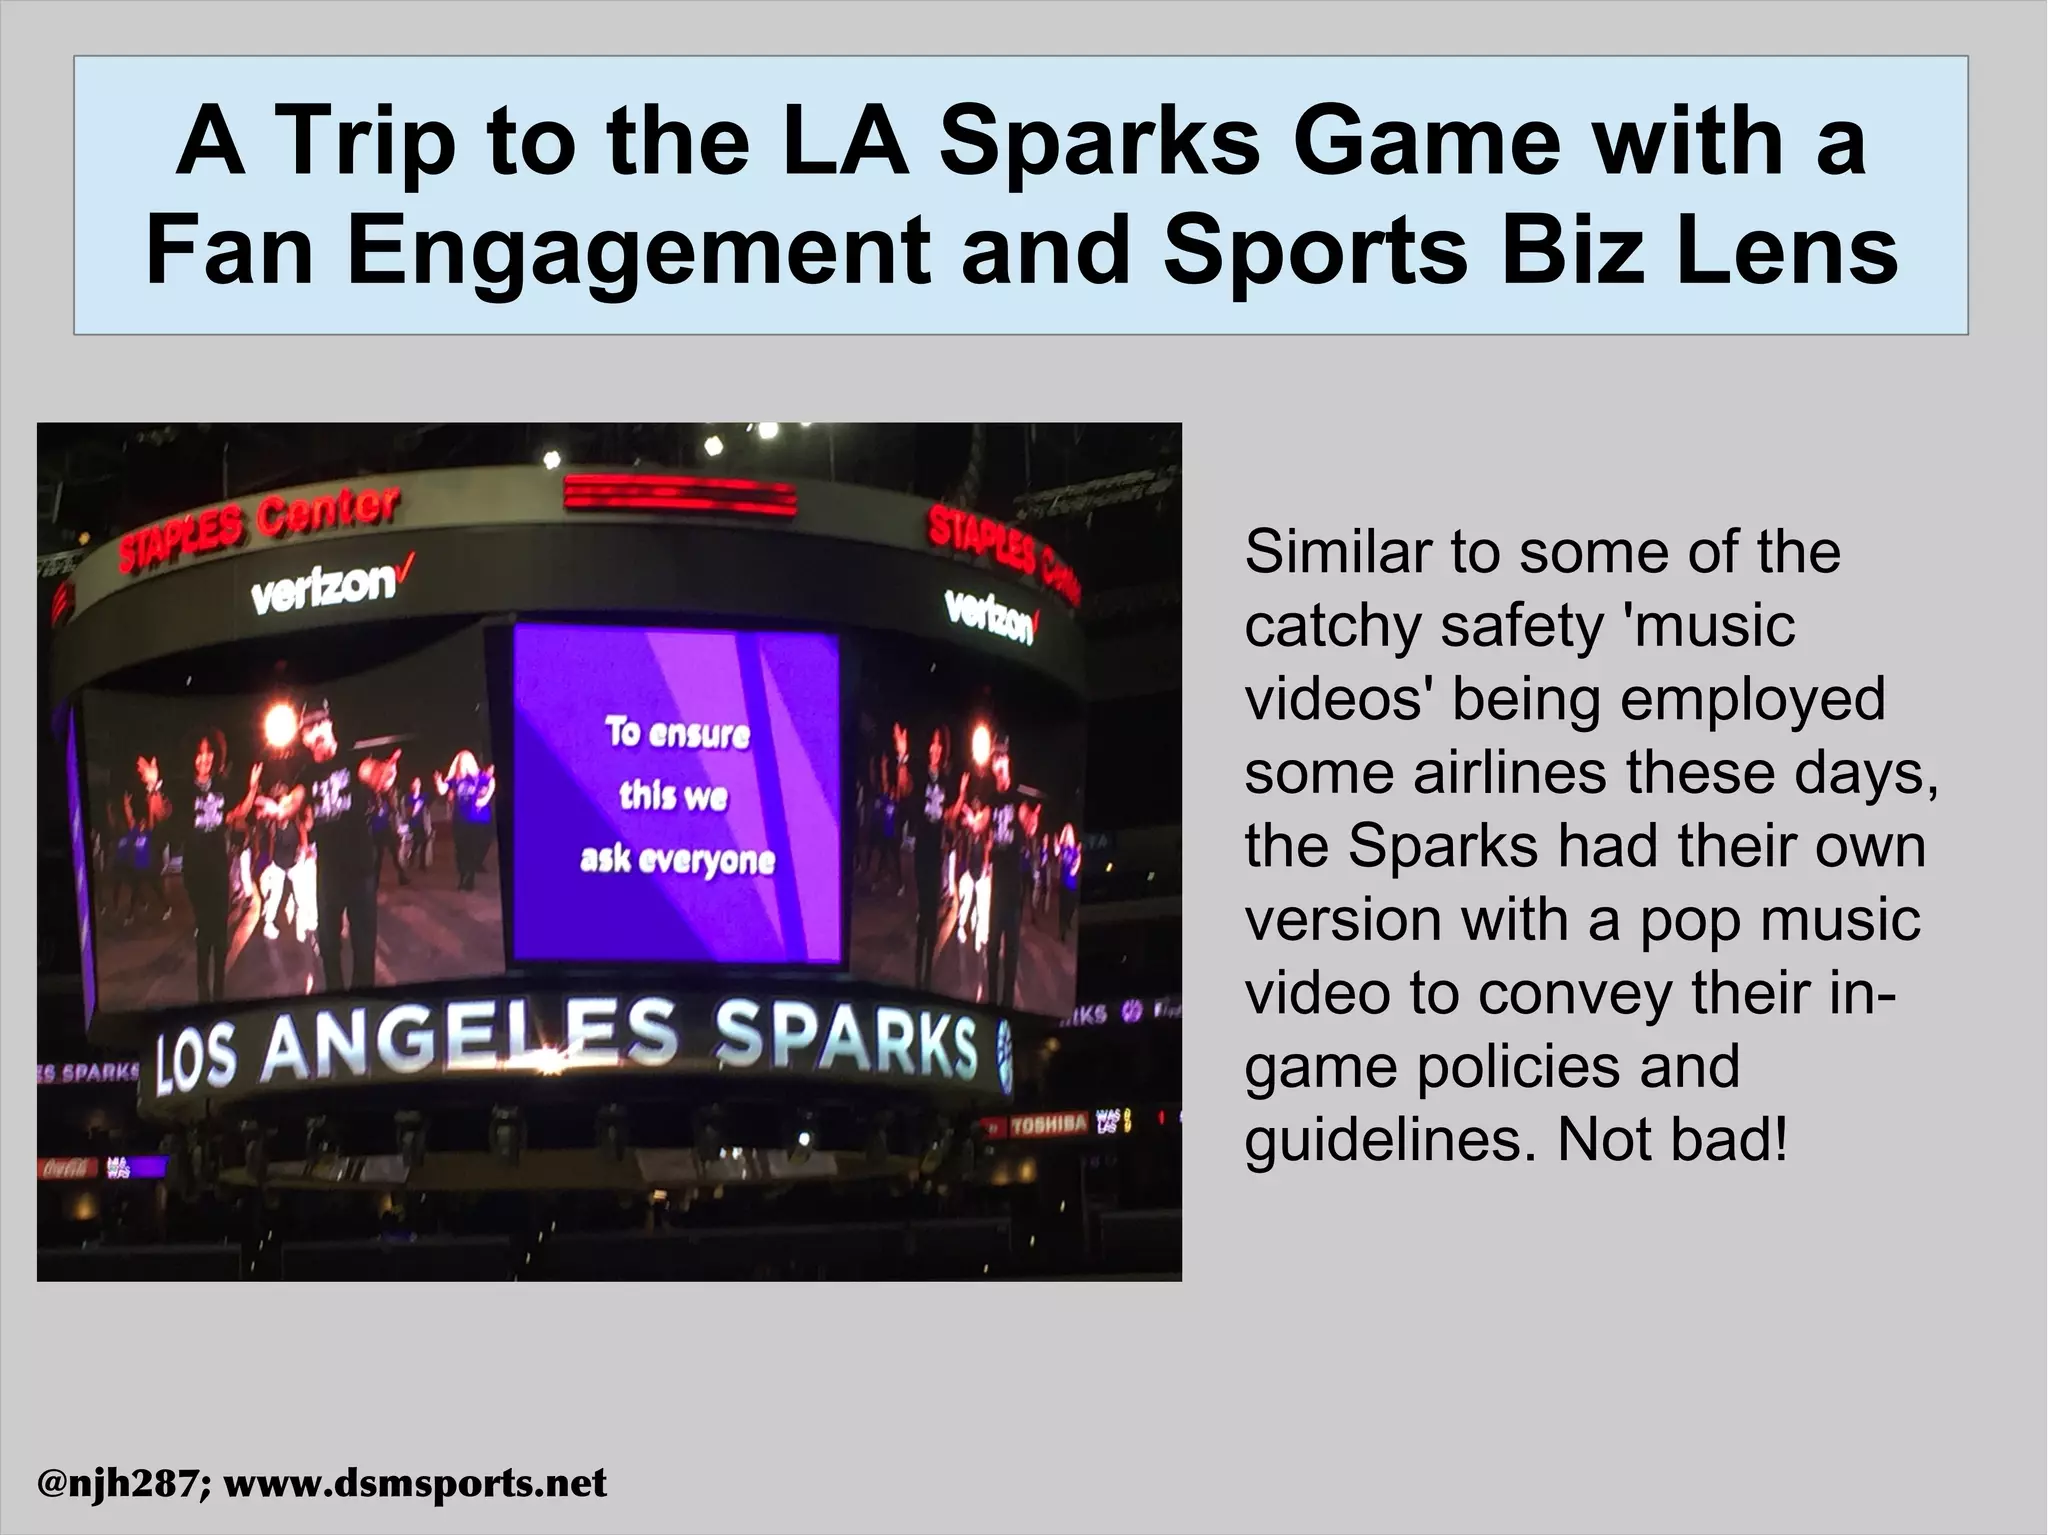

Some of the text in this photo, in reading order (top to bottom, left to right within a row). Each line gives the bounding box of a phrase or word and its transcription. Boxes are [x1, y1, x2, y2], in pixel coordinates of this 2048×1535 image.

[118, 486, 401, 575] STAPLES Center
[928, 503, 1036, 575] STAPLES
[251, 565, 397, 615] verizon
[944, 589, 1034, 646] verizon
[604, 714, 751, 749] To ensure
[618, 778, 729, 811] this we
[579, 841, 776, 881] ask everyone
[156, 997, 979, 1098] LOS ANGELES SPARKS
[62, 1062, 140, 1083] SPARKS
[1012, 1114, 1087, 1135] TOSHIBA
